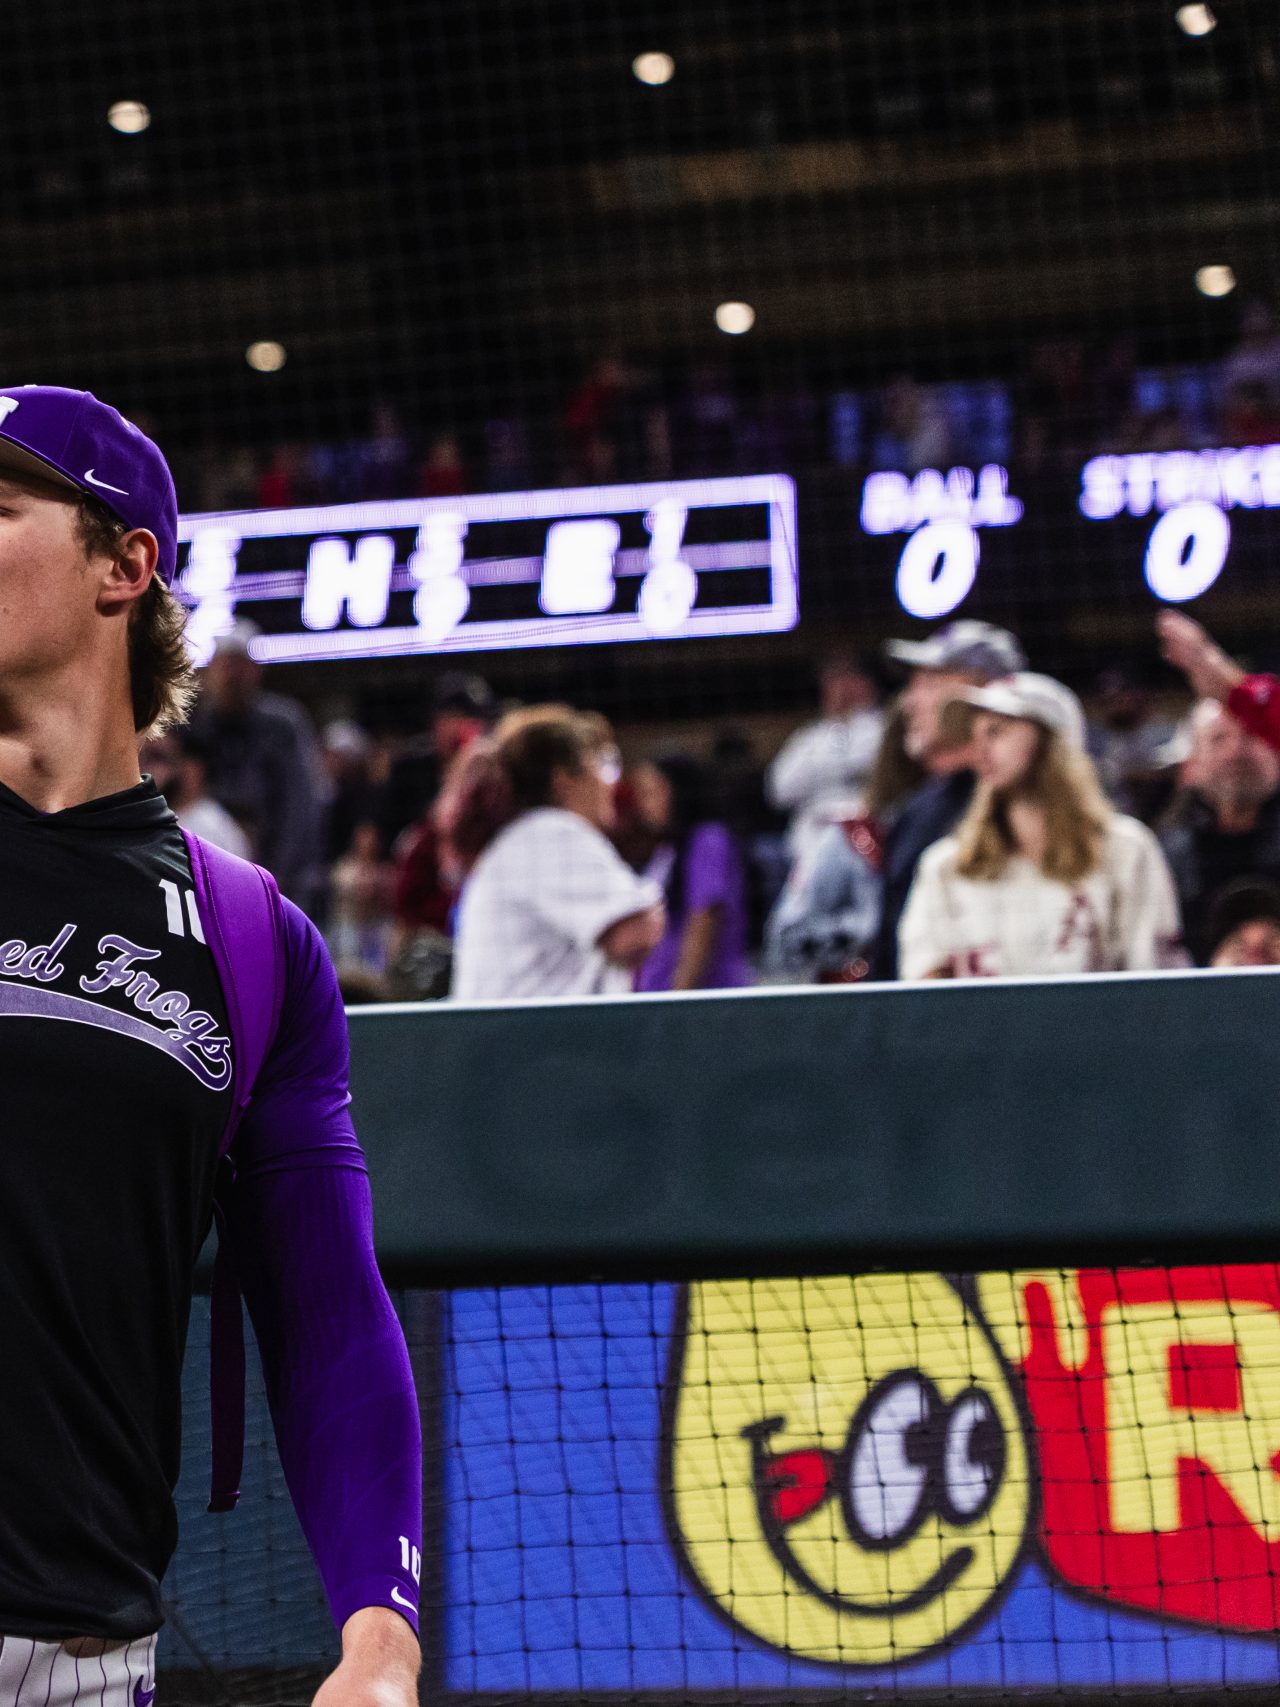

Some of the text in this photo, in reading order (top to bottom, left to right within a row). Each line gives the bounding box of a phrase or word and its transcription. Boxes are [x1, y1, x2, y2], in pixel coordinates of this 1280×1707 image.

[860, 463, 1025, 535] BALL
[895, 520, 981, 619] 0
[1144, 501, 1231, 603] 0
[79, 934, 231, 1064] Frogs
